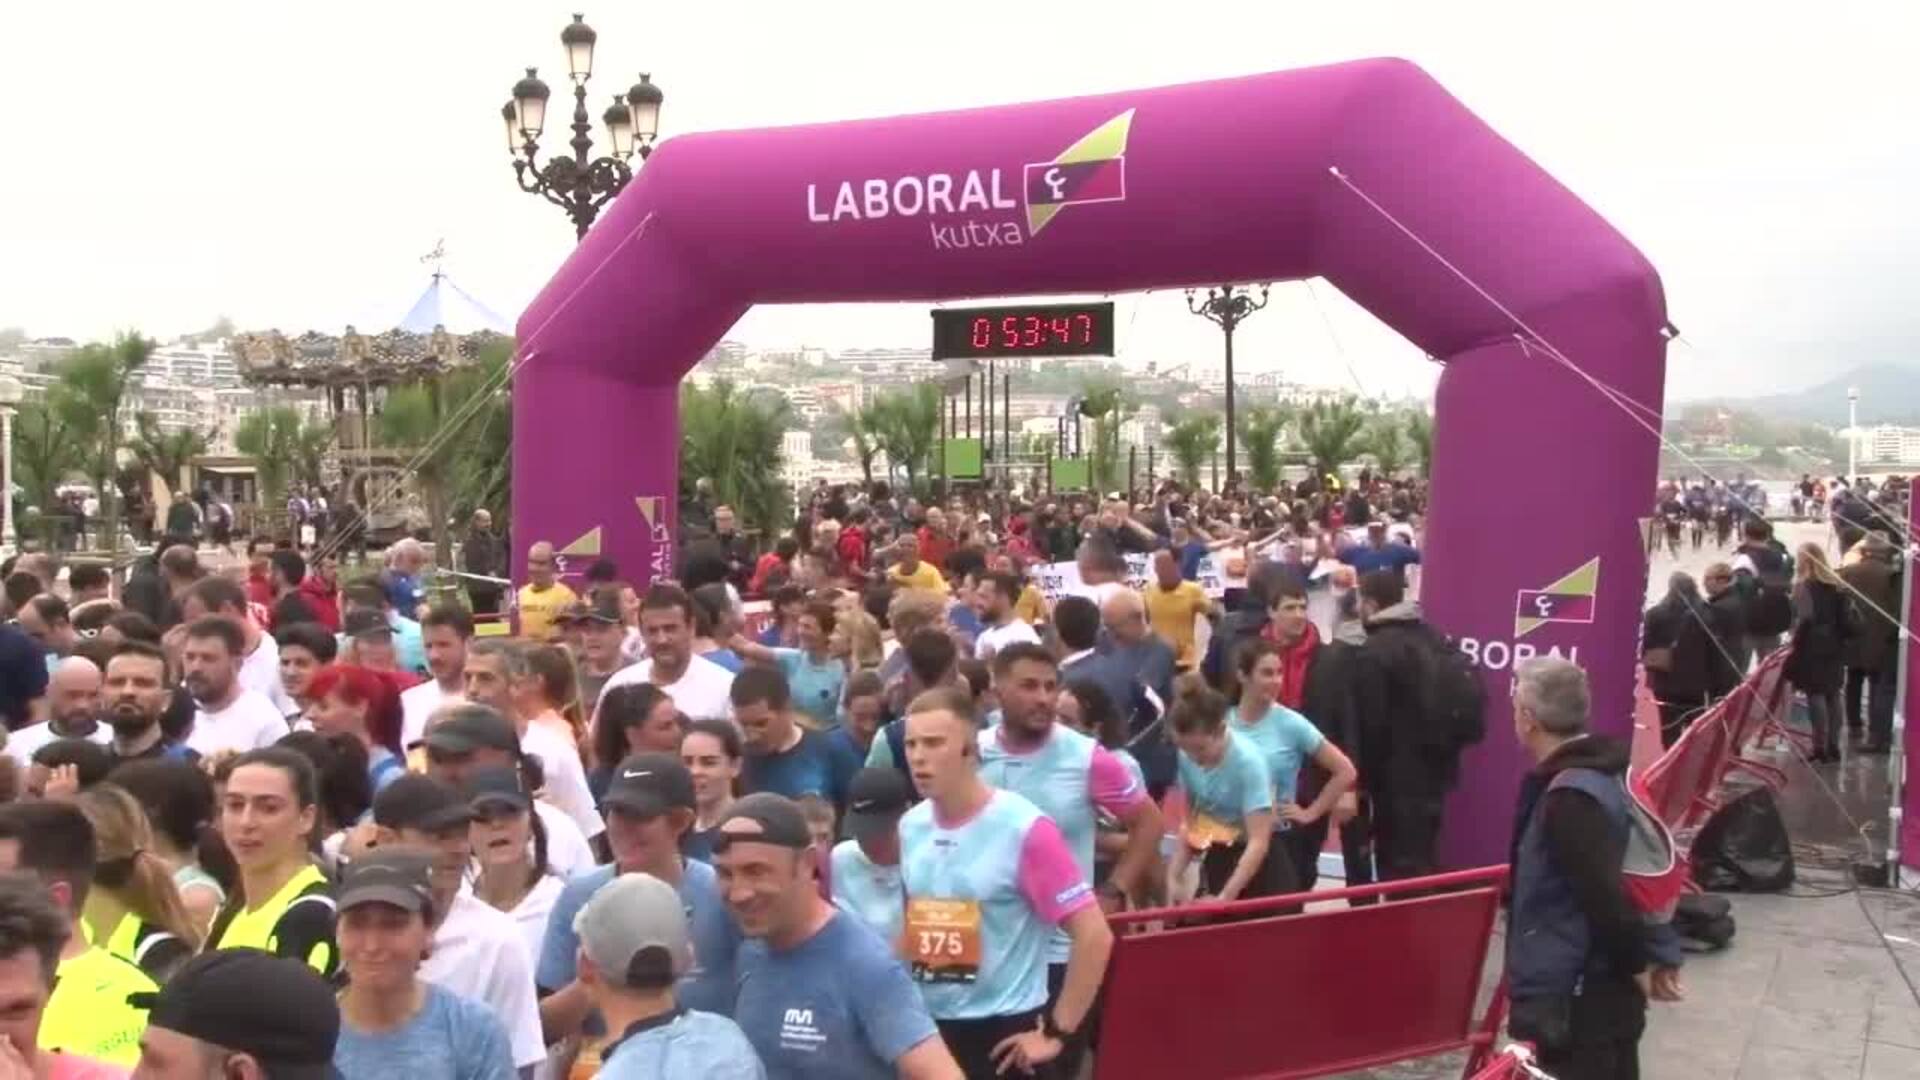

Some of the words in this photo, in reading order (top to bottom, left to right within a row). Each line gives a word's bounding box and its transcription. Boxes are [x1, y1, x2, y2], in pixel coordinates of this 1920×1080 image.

[807, 168, 1017, 222] LABORAL
[931, 220, 1024, 250] kutxa
[971, 317, 992, 349] 0
[1002, 314, 1092, 348] 53:47
[918, 931, 964, 955] 375
